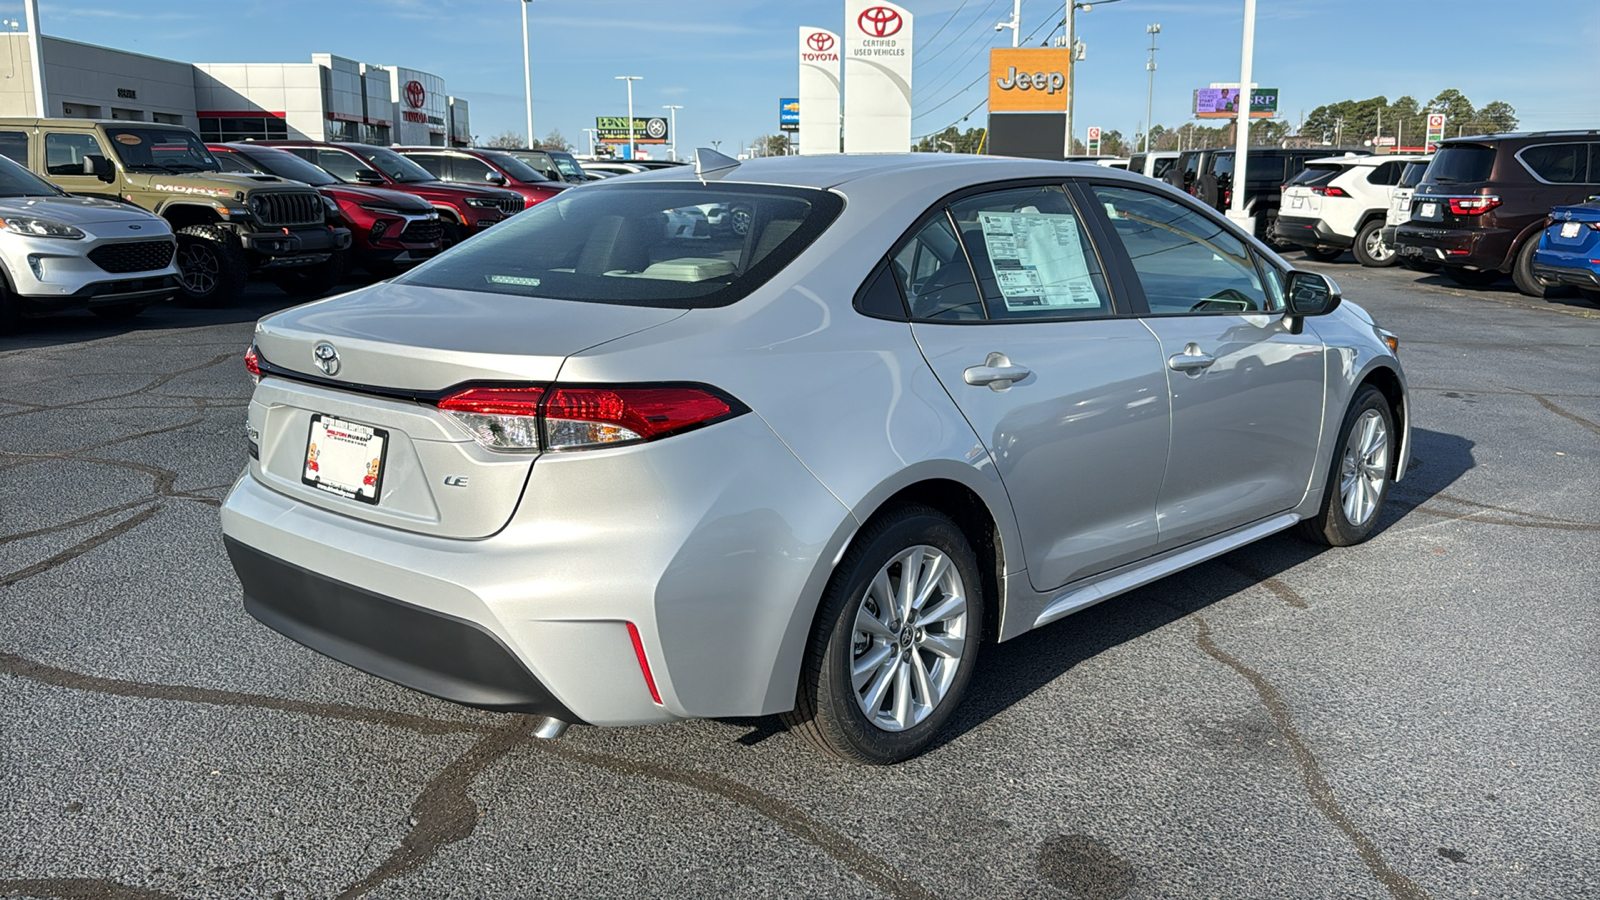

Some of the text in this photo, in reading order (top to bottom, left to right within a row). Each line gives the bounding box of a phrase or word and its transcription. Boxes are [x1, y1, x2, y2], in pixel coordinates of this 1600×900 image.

[862, 39, 896, 47] CERTIFIED
[802, 53, 839, 61] TOYOTA
[854, 48, 872, 56] USED
[997, 66, 1065, 94] Jeep
[402, 111, 427, 124] TOYOTA
[326, 429, 368, 442] MILTON RUBEN
[444, 475, 469, 488] LE
